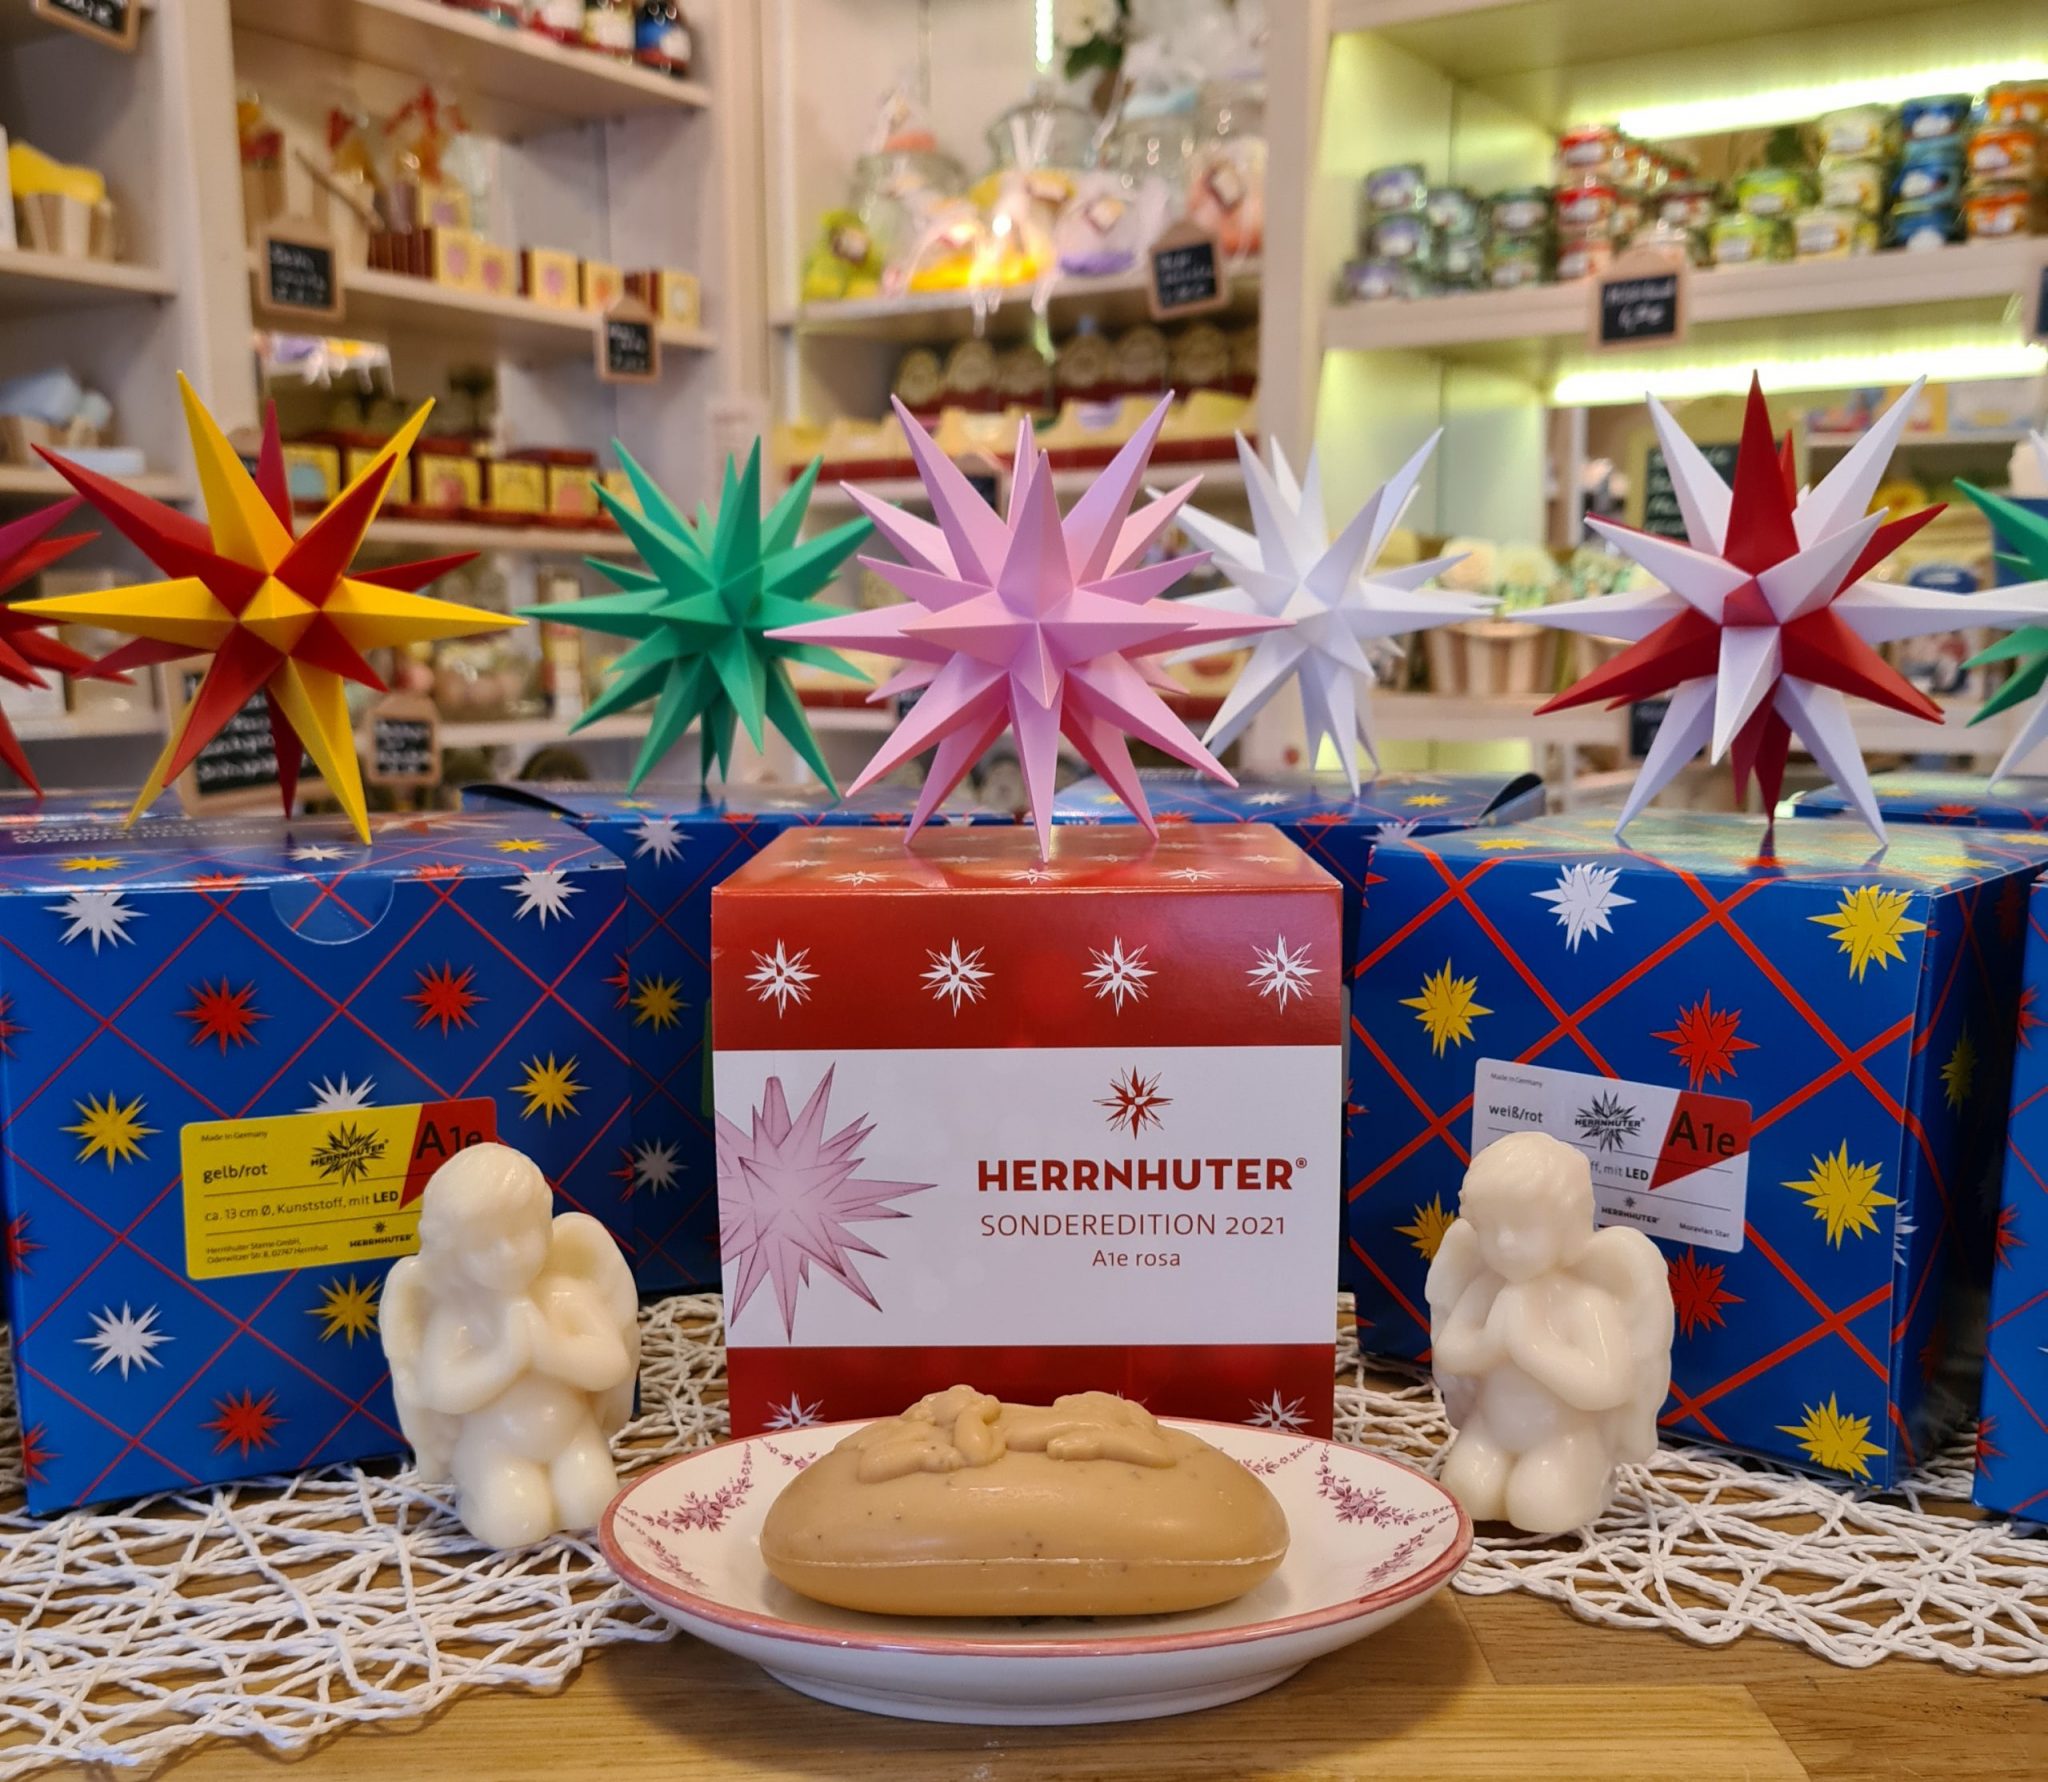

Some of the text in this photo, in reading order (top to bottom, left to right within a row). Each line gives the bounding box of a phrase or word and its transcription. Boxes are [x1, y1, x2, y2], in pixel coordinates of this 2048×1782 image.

[1488, 1104, 1543, 1124] weiß/rot
[1667, 1109, 1736, 1156] A1e
[203, 1163, 268, 1185] gelb/rot
[1603, 1165, 1623, 1178] mit
[1625, 1166, 1649, 1181] LED
[204, 1209, 222, 1222] ca.
[224, 1208, 237, 1220] 13
[239, 1208, 259, 1219] cm
[277, 1196, 347, 1214] Kunststoff,
[349, 1194, 370, 1207] mit
[373, 1190, 400, 1204] LED
[980, 1212, 1286, 1237] SONDEREDITION 2021
[1092, 1249, 1181, 1267] A1e rosa
